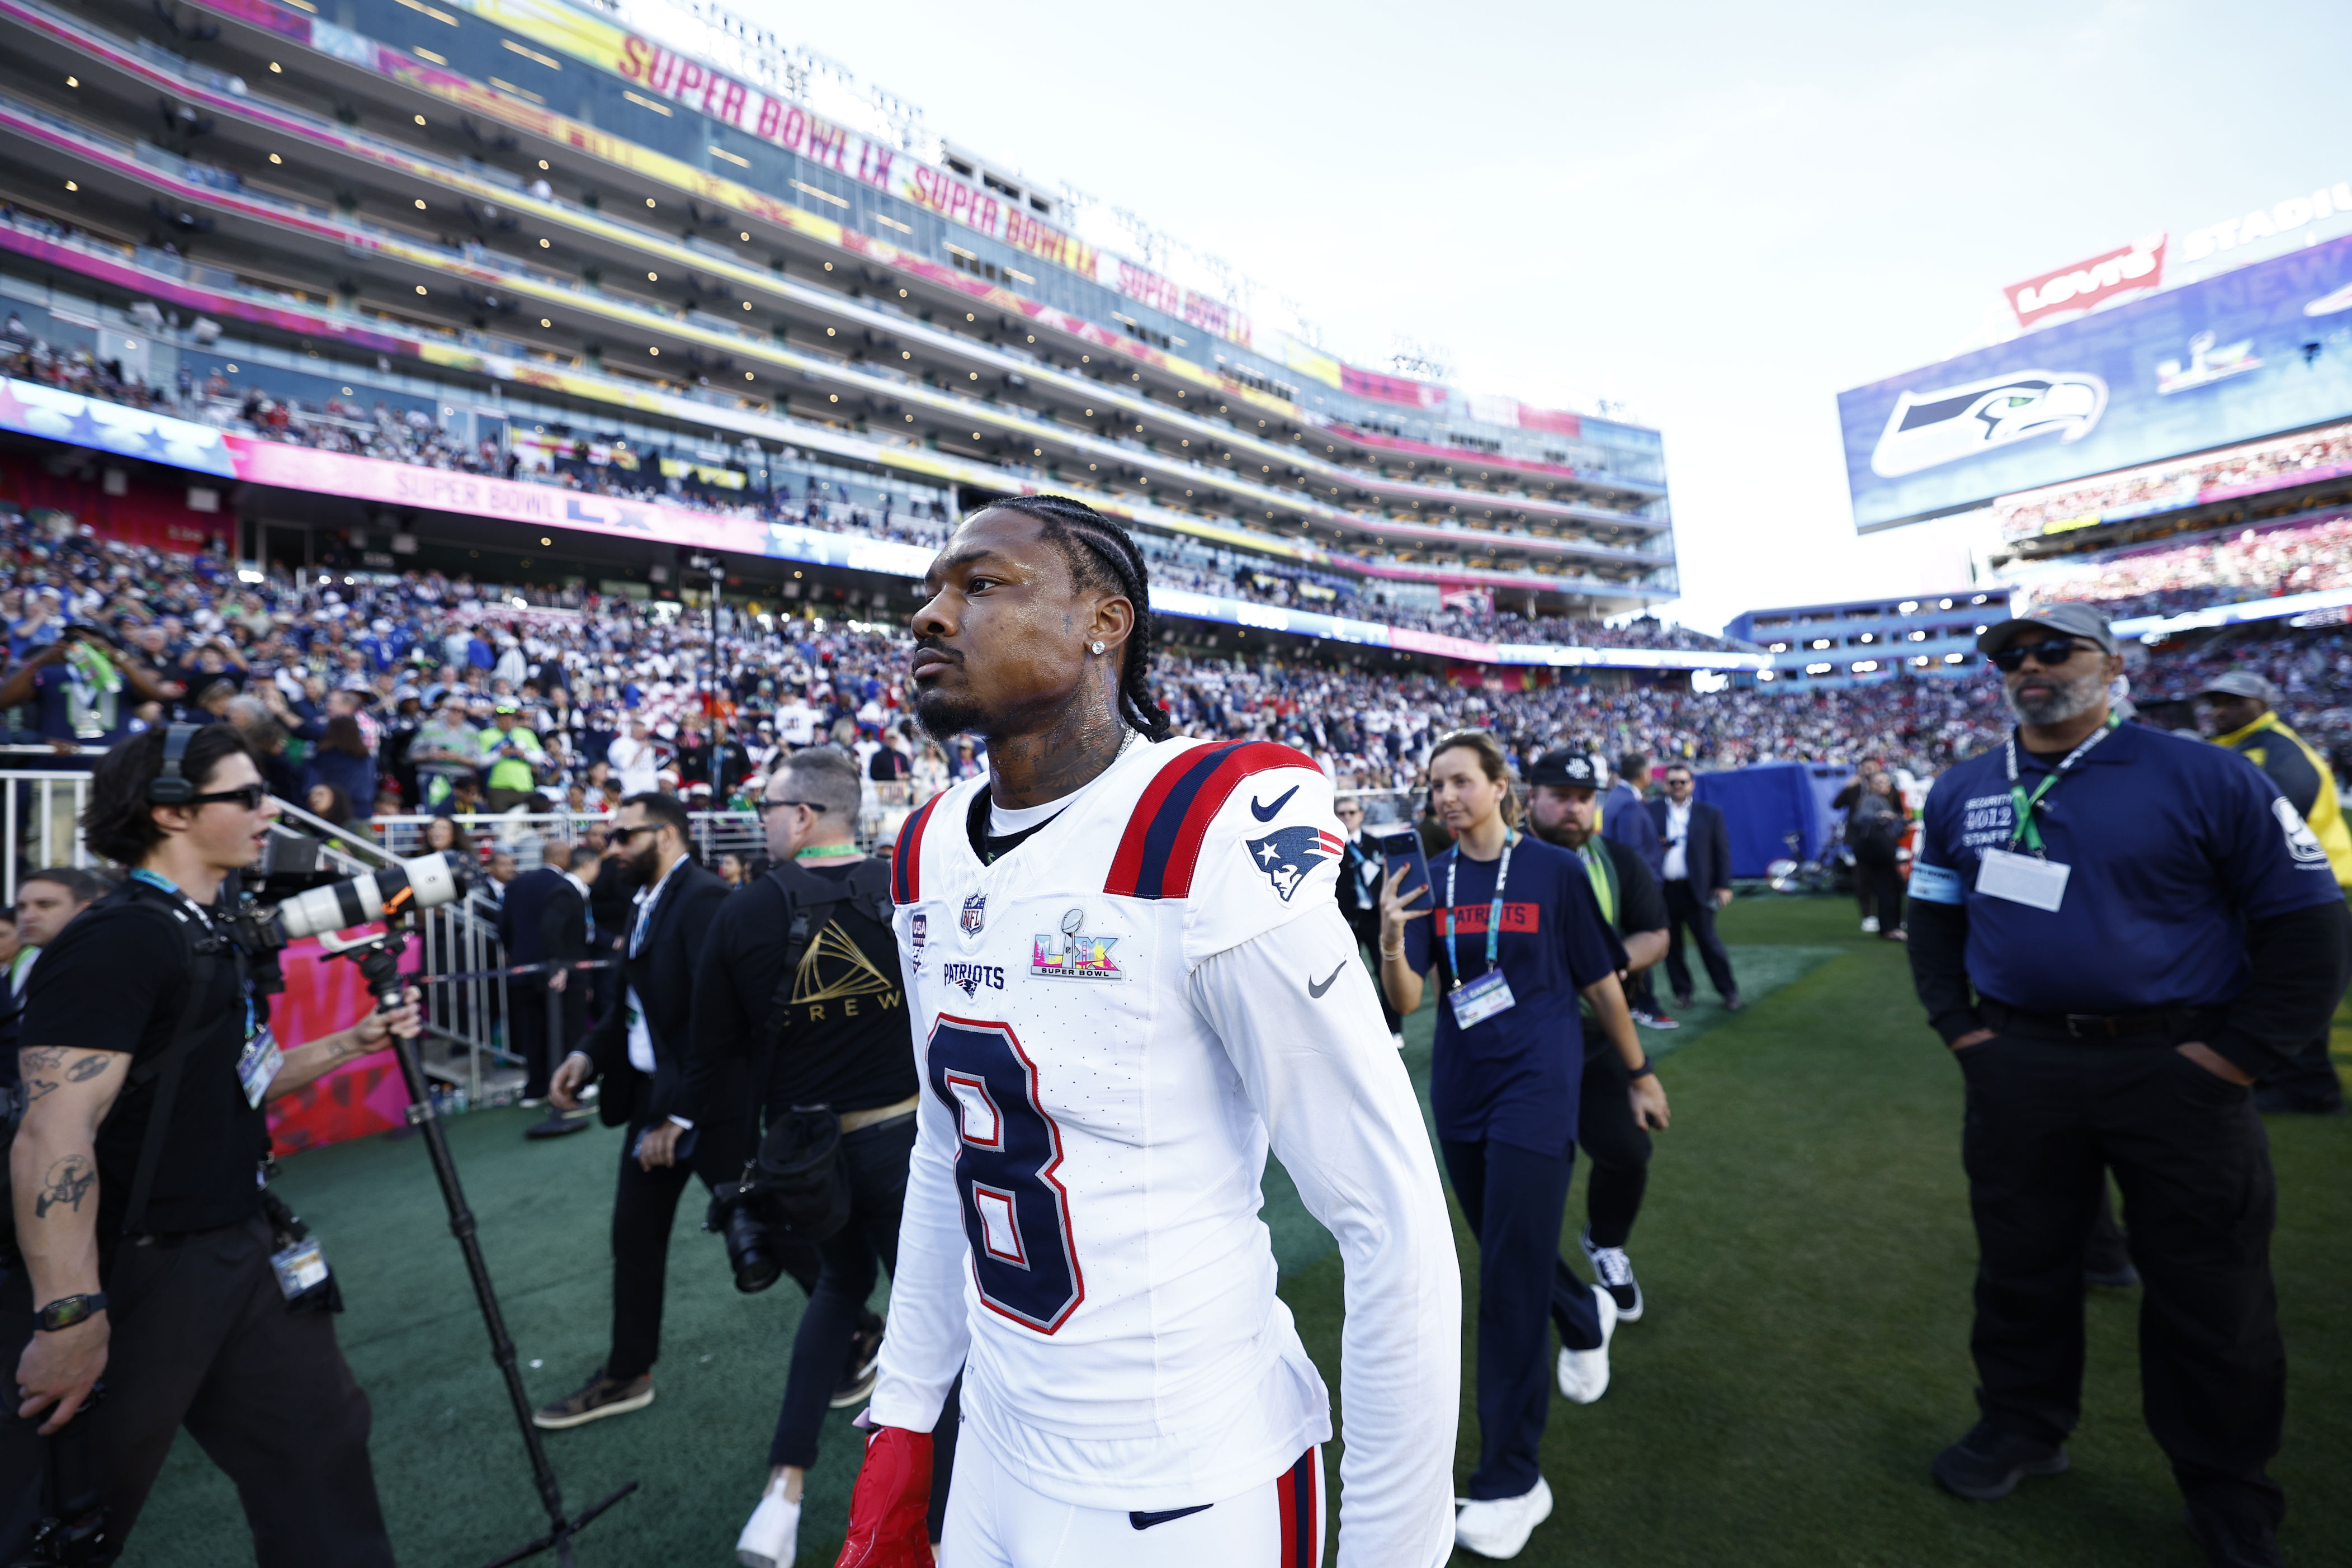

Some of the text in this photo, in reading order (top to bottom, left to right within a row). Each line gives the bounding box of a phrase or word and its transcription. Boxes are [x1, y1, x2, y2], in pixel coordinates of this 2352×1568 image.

[618, 35, 893, 189] SUPER BOWL LX
[912, 165, 998, 235] SUPER
[1007, 208, 1066, 263] BOWL
[1117, 261, 1178, 317] SUPER
[398, 471, 479, 508] SUPER
[490, 486, 556, 518] BOWL
[1963, 806, 2012, 830] 4012
[1962, 829, 2013, 847] STAFF
[962, 910, 980, 928] NFL
[1448, 905, 1526, 925] ATRITS
[913, 921, 926, 935] USA
[944, 963, 1004, 990] PATRIOTS
[1041, 967, 1074, 976] SUPER
[925, 1012, 1085, 1335] 8
